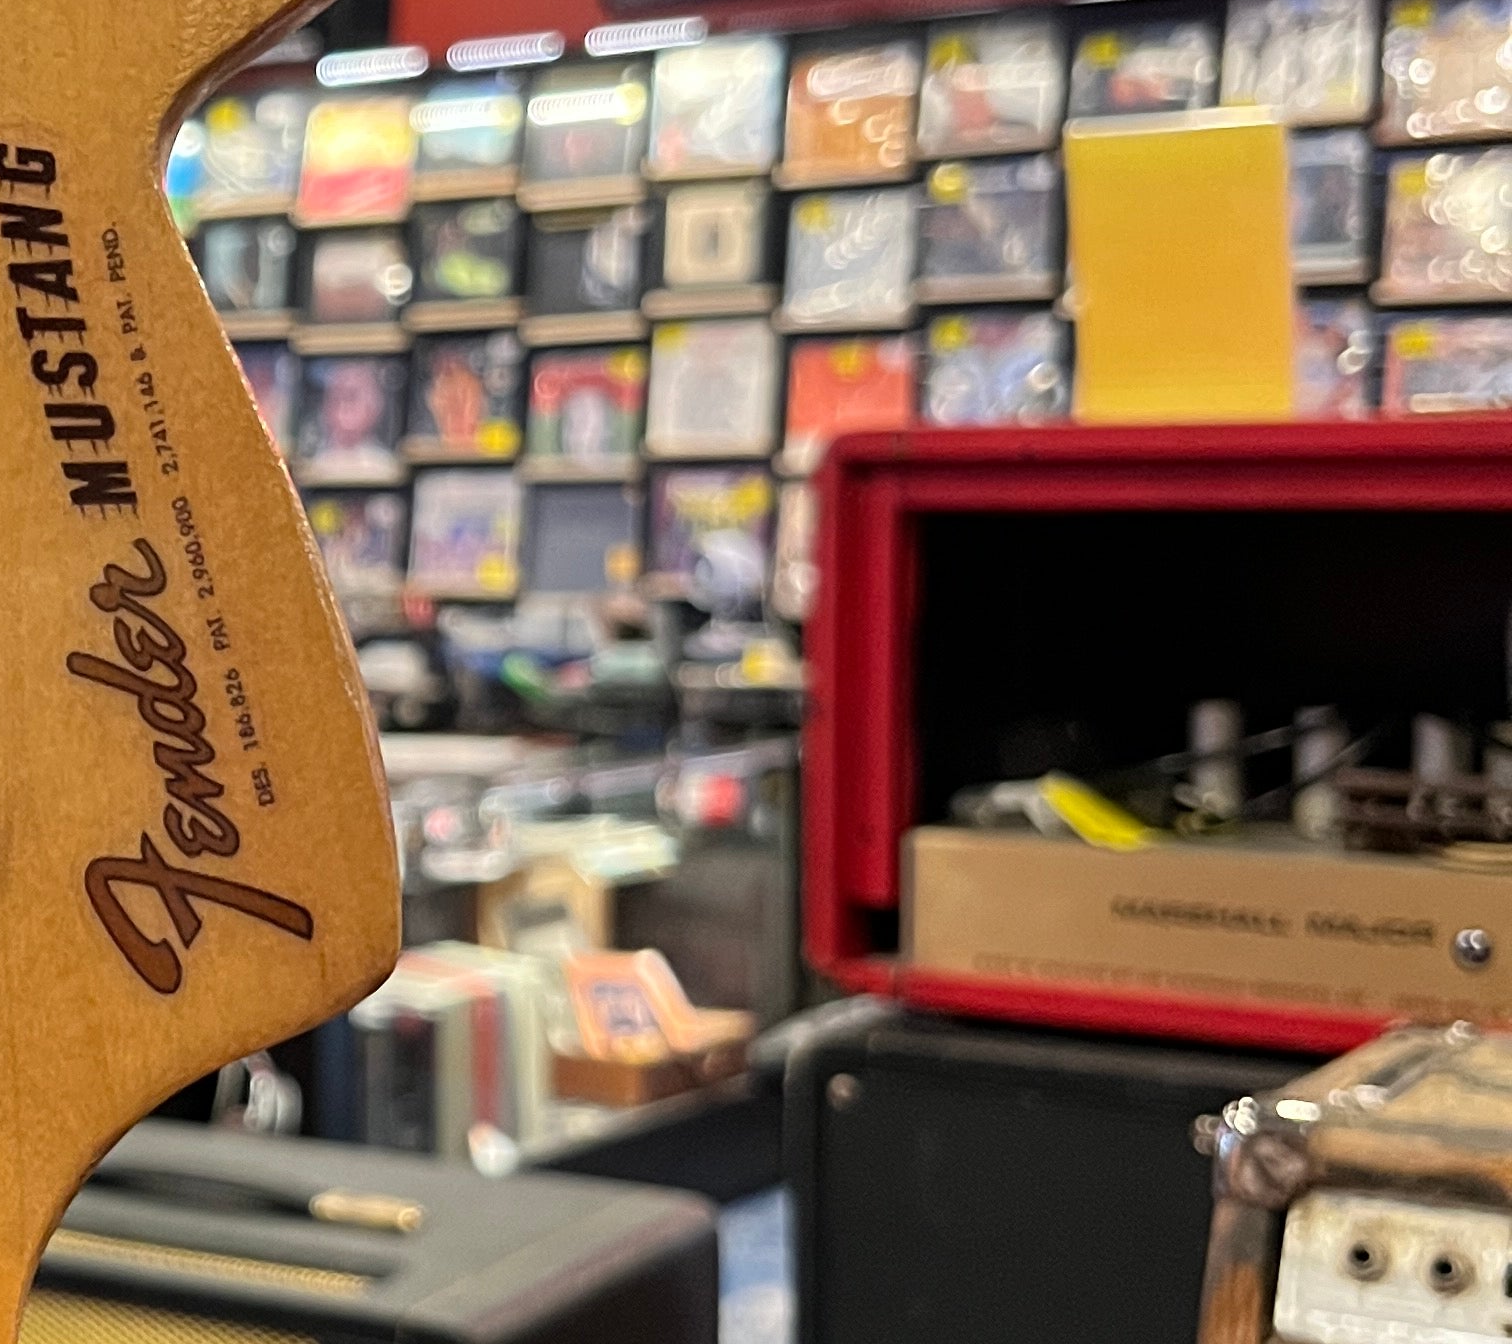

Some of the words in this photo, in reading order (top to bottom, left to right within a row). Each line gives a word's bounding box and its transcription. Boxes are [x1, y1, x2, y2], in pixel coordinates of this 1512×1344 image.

[101, 221, 127, 283] PEND.
[117, 292, 139, 335] PAT.
[66, 537, 314, 994] Fender
